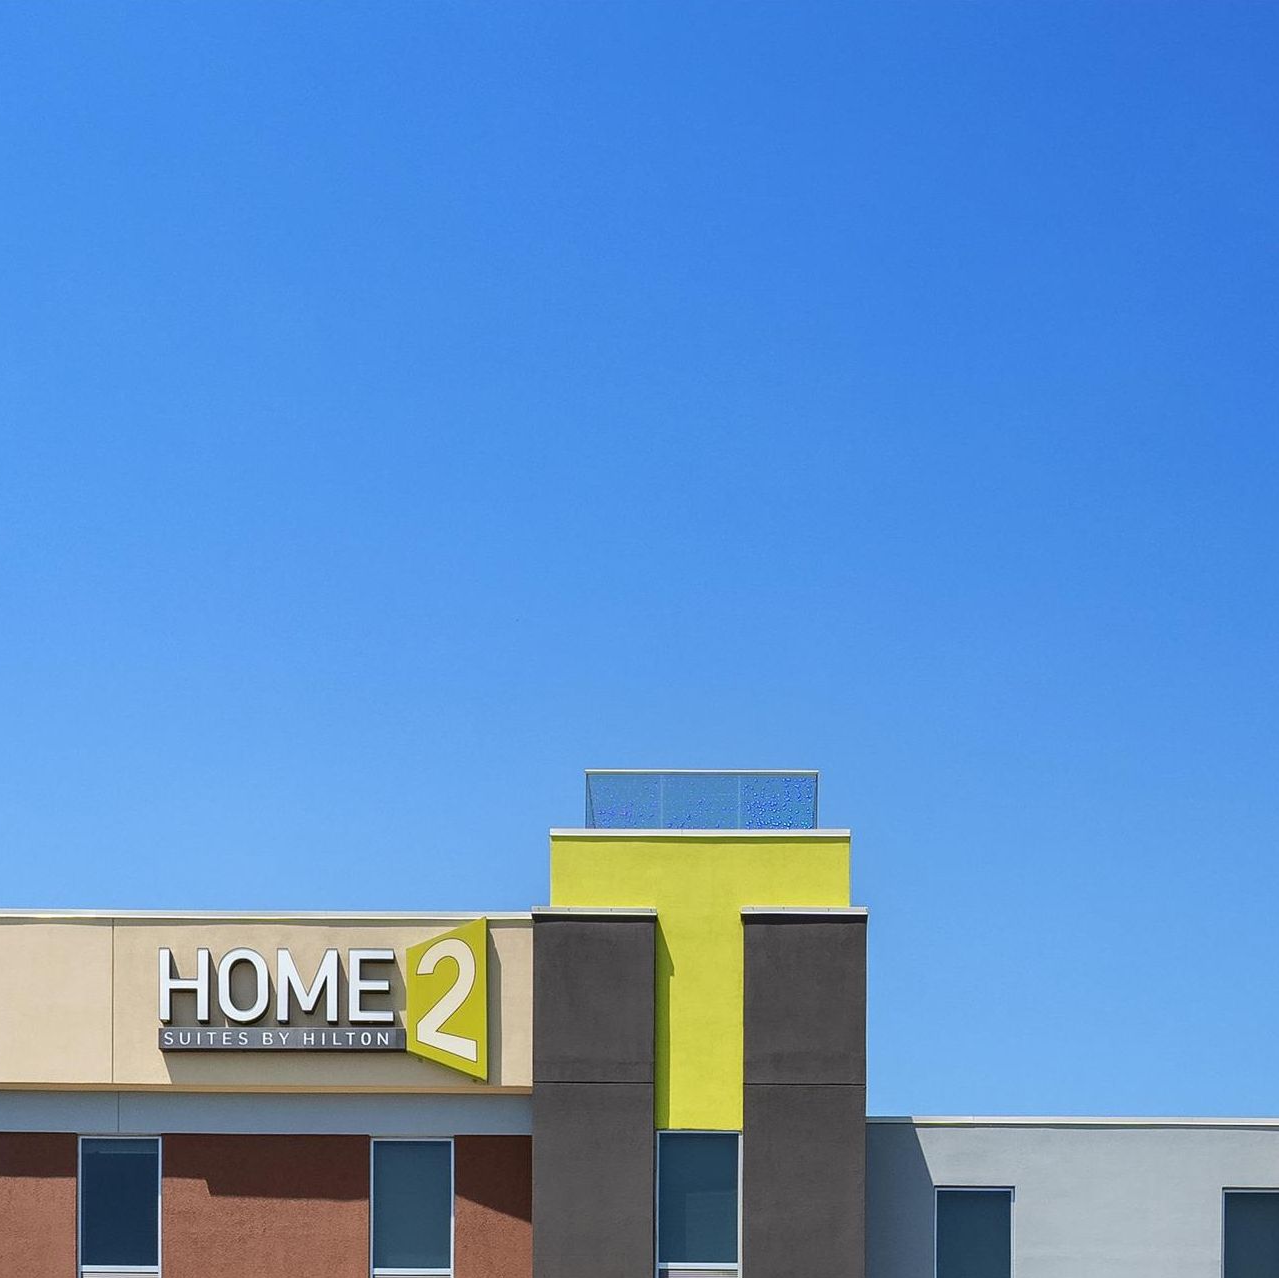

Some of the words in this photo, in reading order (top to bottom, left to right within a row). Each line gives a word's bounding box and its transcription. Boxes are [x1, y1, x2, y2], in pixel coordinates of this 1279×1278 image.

[159, 947, 395, 1024] HOME
[416, 938, 478, 1063] 2
[164, 1031, 248, 1045] SUITES
[262, 1031, 290, 1045] BY
[303, 1031, 390, 1045] HILTON
